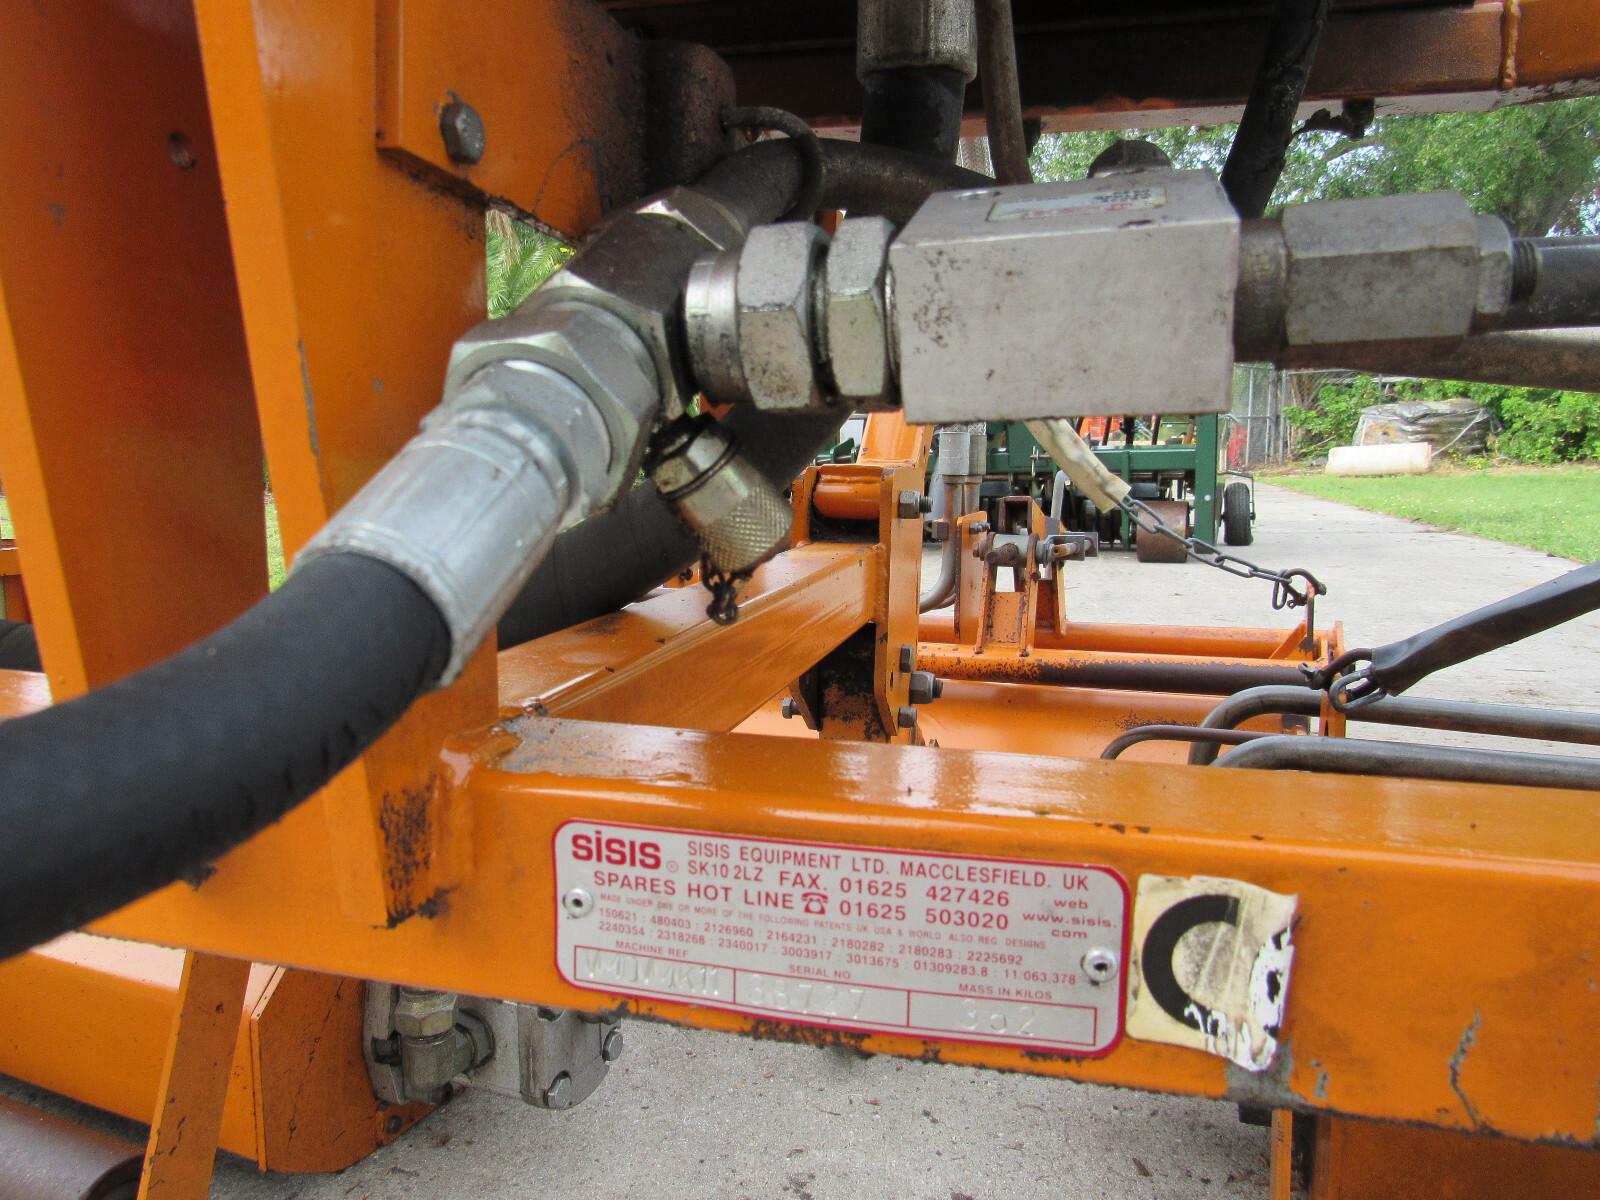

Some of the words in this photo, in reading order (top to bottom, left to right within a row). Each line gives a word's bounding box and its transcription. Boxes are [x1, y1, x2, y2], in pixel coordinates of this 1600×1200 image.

[687, 840, 731, 860] SISIS
[740, 846, 841, 872] EQUIPMENT
[851, 857, 890, 875] LTD.
[1063, 873, 1089, 892] UK
[688, 860, 729, 879] SK10
[734, 864, 764, 882] 2LZ
[780, 871, 828, 892] FAX.
[840, 877, 907, 899] 01625
[926, 884, 1010, 908] 427426
[594, 870, 676, 896] SPARES
[688, 882, 732, 903] HOT
[744, 890, 795, 910] LINE
[840, 899, 907, 922] 01625
[925, 908, 1009, 931] 503020
[600, 893, 621, 904] MADE
[626, 897, 653, 907] UNDER
[656, 901, 673, 911] ONE
[678, 904, 690, 912] OR
[694, 906, 718, 916] MORE
[722, 909, 734, 918] OF
[738, 911, 754, 921] THE
[758, 914, 809, 927] FOLLOWING
[814, 920, 852, 932] PATENTS
[856, 924, 868, 933] UK
[874, 925, 892, 936] USA
[908, 930, 942, 940] WORLD
[948, 933, 973, 943] ALSO
[1006, 938, 1046, 950] DESIGNS
[1054, 898, 1088, 910] web
[598, 920, 645, 936] 2240354
[657, 930, 706, 945] 2318268
[718, 937, 768, 953] 2340017
[781, 946, 832, 960] 3003917
[846, 954, 899, 968] 3013675
[913, 960, 988, 978] 01309283.8
[600, 908, 637, 922] 150621
[650, 914, 692, 930] 480403
[704, 922, 754, 938] 2126960
[766, 930, 817, 946] 2164231
[832, 937, 884, 952] 2180282
[898, 944, 953, 960] 2180283
[967, 950, 1023, 966] 2225692
[616, 940, 664, 954] MACHINE
[668, 948, 688, 958] REF
[1051, 928, 1088, 939] com
[789, 965, 830, 978] SERIAL
[834, 970, 851, 980] NO
[958, 984, 994, 995] MASS
[998, 986, 1011, 996] IN
[1015, 988, 1052, 1000] KILOS
